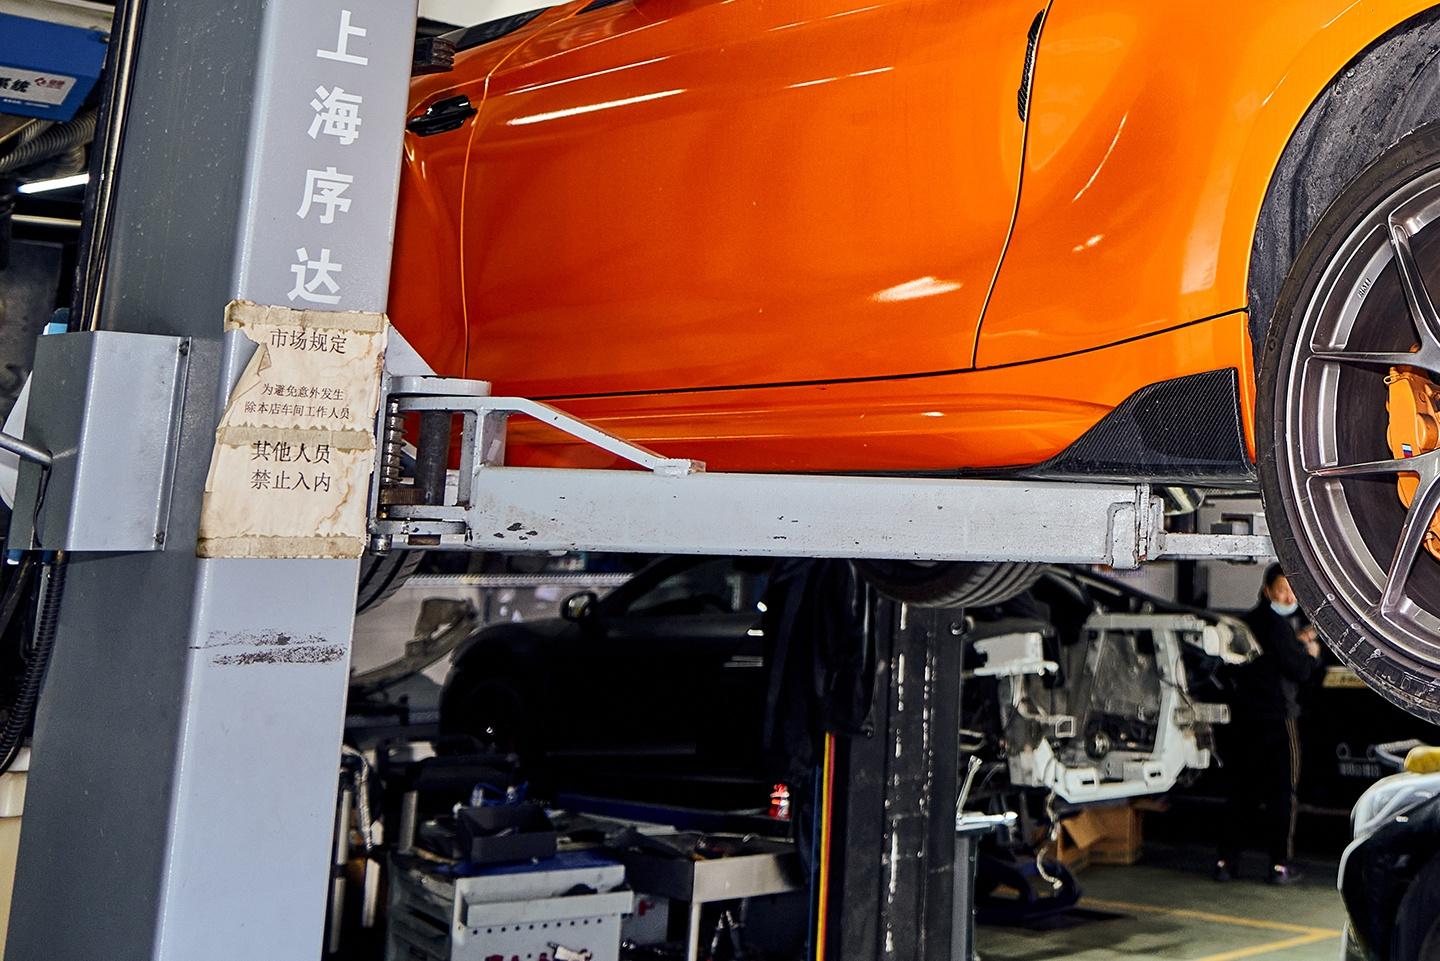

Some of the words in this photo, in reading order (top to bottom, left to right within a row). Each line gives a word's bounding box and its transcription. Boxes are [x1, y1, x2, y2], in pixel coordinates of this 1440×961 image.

[287, 9, 369, 305] 上海序达
[270, 328, 347, 355] 市场规定
[262, 383, 344, 401] 为避免意外发生
[244, 401, 350, 419] 除本店车间工作人员
[251, 440, 331, 465] 其他人员
[250, 469, 331, 493] 禁止入内
